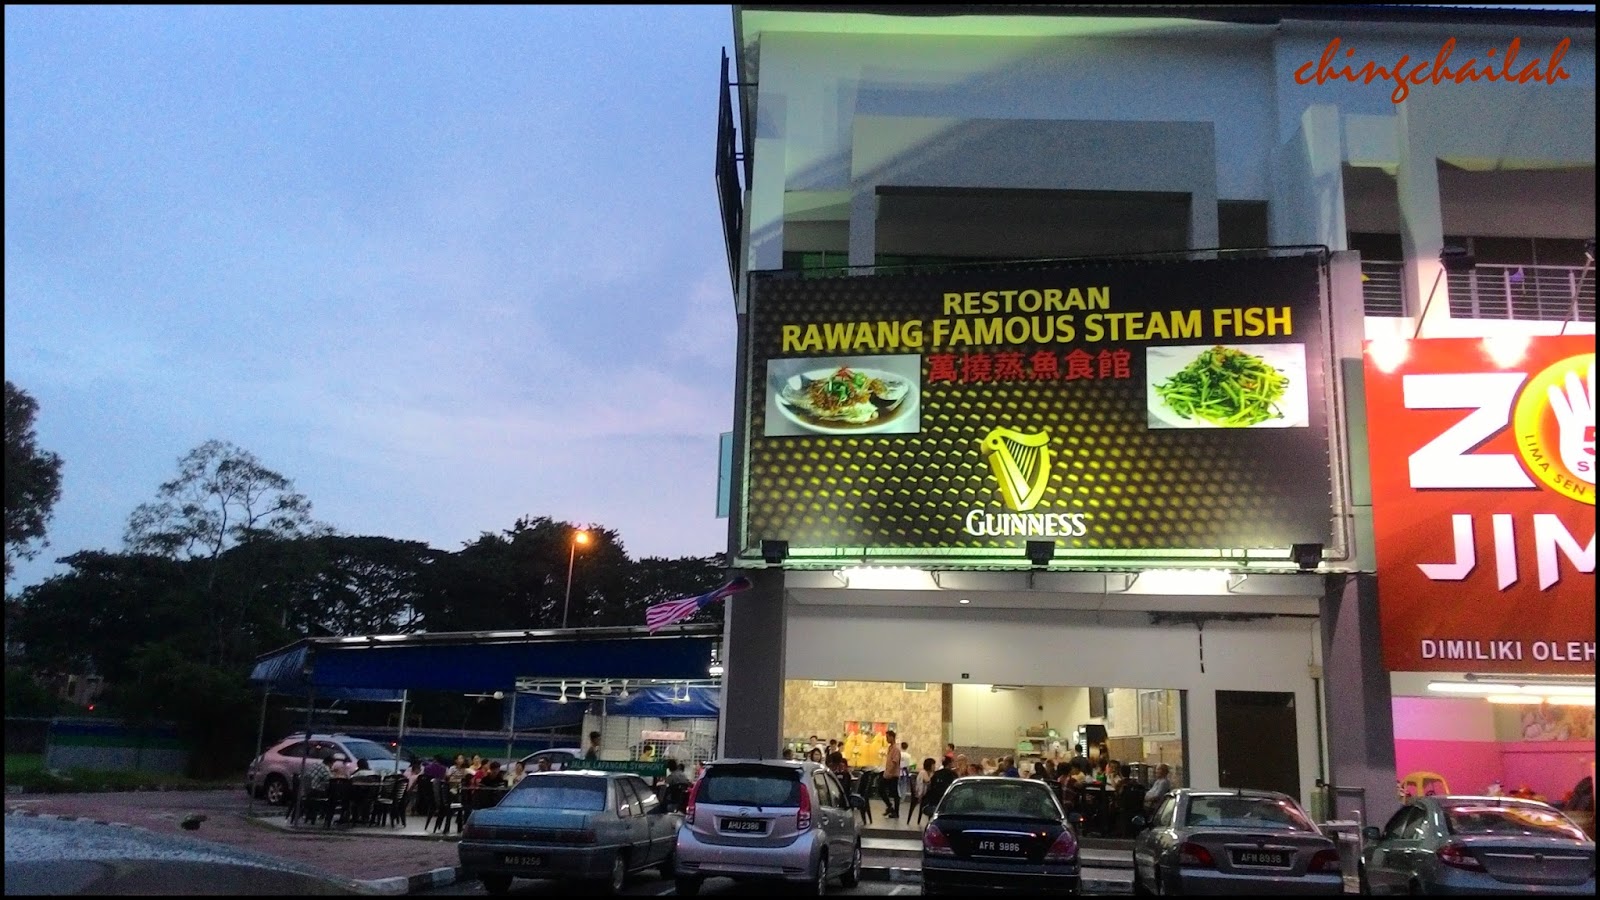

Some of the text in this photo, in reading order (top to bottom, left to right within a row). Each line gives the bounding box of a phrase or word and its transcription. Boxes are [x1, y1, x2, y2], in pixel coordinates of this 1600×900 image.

[944, 287, 1111, 314] RESTORAN
[782, 307, 1293, 352] RAWANG FAMOUS STEAM FISH
[966, 509, 1087, 537] GUINNESS
[1421, 639, 1595, 662] DIMILIKI OLEH
[979, 841, 995, 851] AFR
